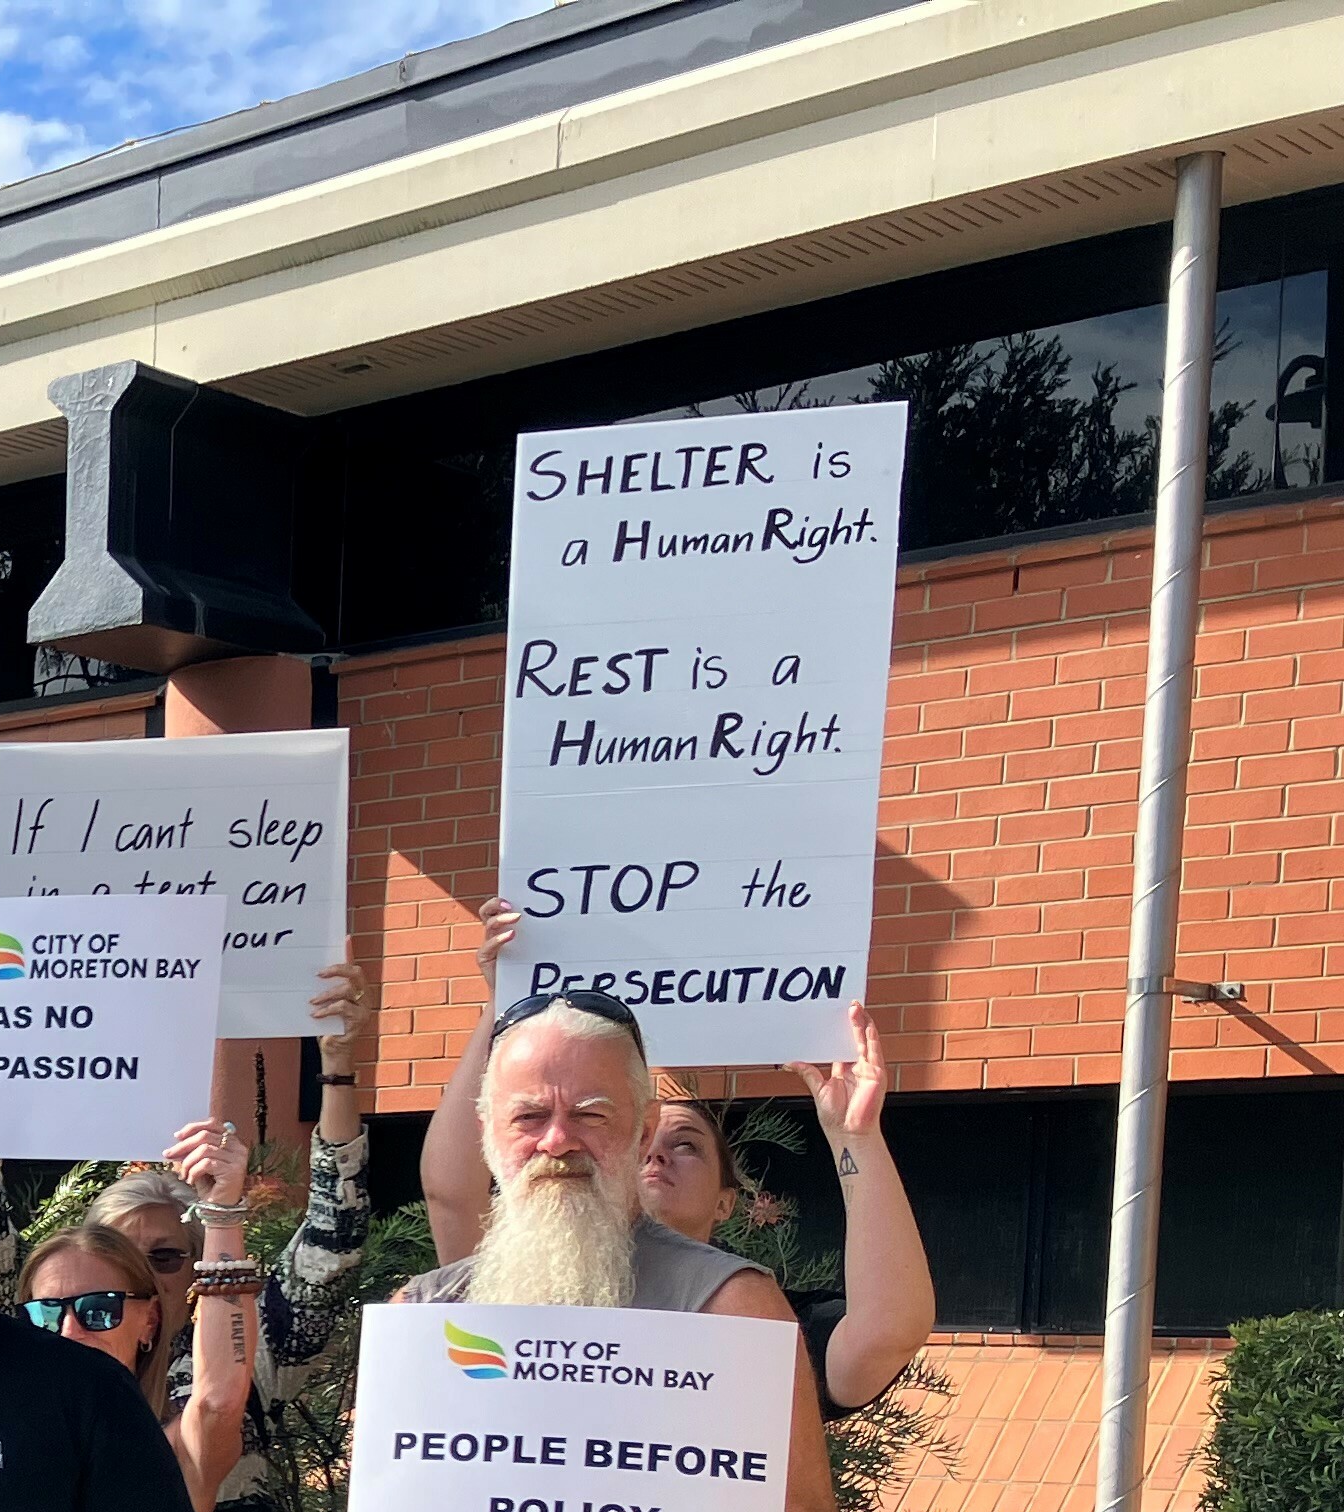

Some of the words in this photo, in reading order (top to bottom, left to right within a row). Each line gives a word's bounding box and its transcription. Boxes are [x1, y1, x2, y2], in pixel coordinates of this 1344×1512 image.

[526, 442, 775, 501] SHELTER
[813, 441, 851, 480] is
[561, 539, 589, 567] a
[515, 639, 670, 699] REST
[692, 646, 728, 690] is
[771, 654, 801, 686] a
[549, 719, 698, 767] Human
[709, 711, 842, 776] Right.
[12, 798, 54, 855] If
[80, 798, 100, 853] I
[115, 807, 194, 853] cant
[228, 799, 323, 863] sleep
[242, 880, 307, 906] can
[523, 860, 700, 918] STOP
[741, 859, 812, 908] the
[32, 933, 84, 955] CITY
[88, 933, 120, 954] OF
[29, 958, 148, 979] MORETON
[155, 958, 201, 979] BAY
[44, 1005, 94, 1029] NO
[514, 1339, 577, 1359] CITY
[583, 1341, 621, 1361] OF
[513, 1361, 654, 1387] MORETON
[663, 1369, 715, 1391] BAY
[394, 1432, 567, 1466] PEOPLE
[584, 1438, 768, 1483] BEFORE
